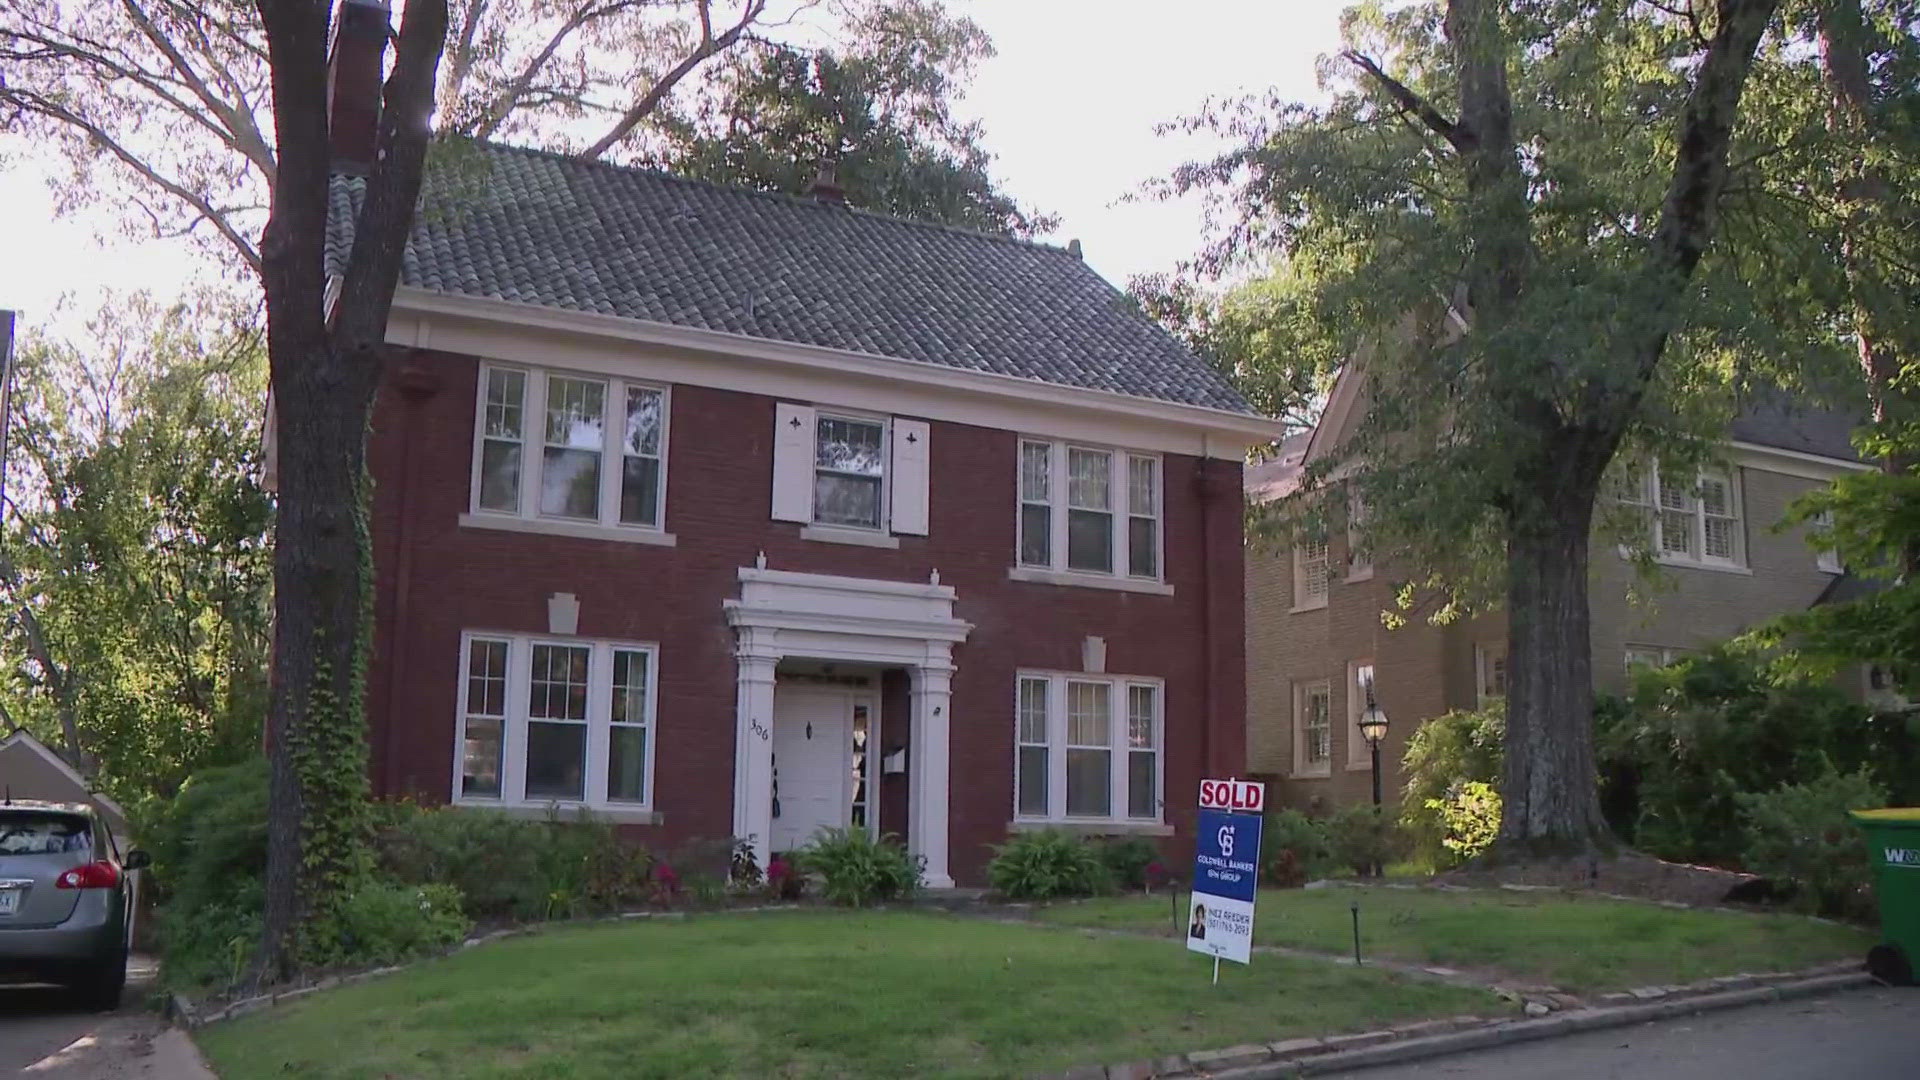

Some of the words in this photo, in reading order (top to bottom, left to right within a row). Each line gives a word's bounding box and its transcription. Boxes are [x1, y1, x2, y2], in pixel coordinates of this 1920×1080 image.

[750, 718, 768, 740] 306
[1201, 781, 1260, 808] SOLD
[1197, 854, 1228, 868] COLDWELL
[1228, 859, 1254, 872] BANKER
[1219, 871, 1242, 882] GROUP
